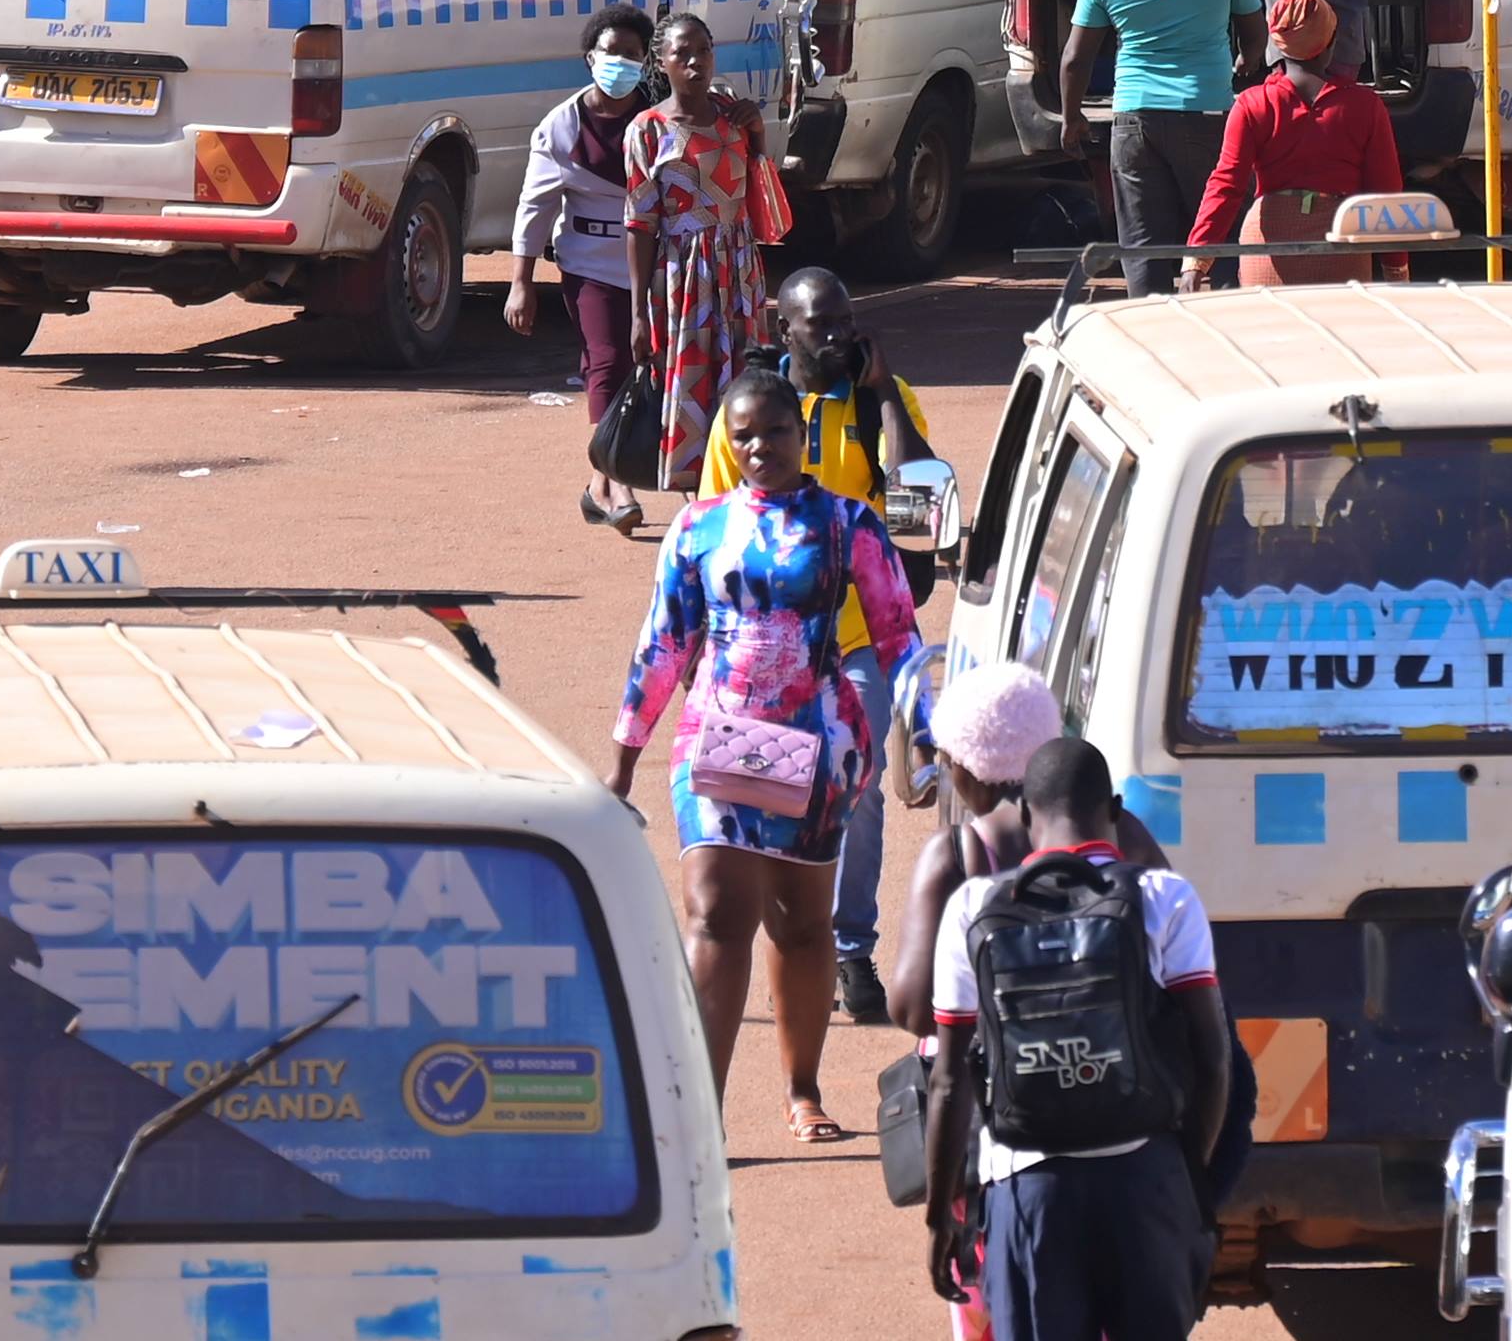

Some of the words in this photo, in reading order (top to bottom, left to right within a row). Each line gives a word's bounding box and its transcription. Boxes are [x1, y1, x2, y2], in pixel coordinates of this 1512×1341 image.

[1351, 203, 1439, 232] TAXI
[17, 550, 124, 586] TAXI
[8, 850, 502, 936] SIMBA
[18, 945, 578, 1031] EMENT
